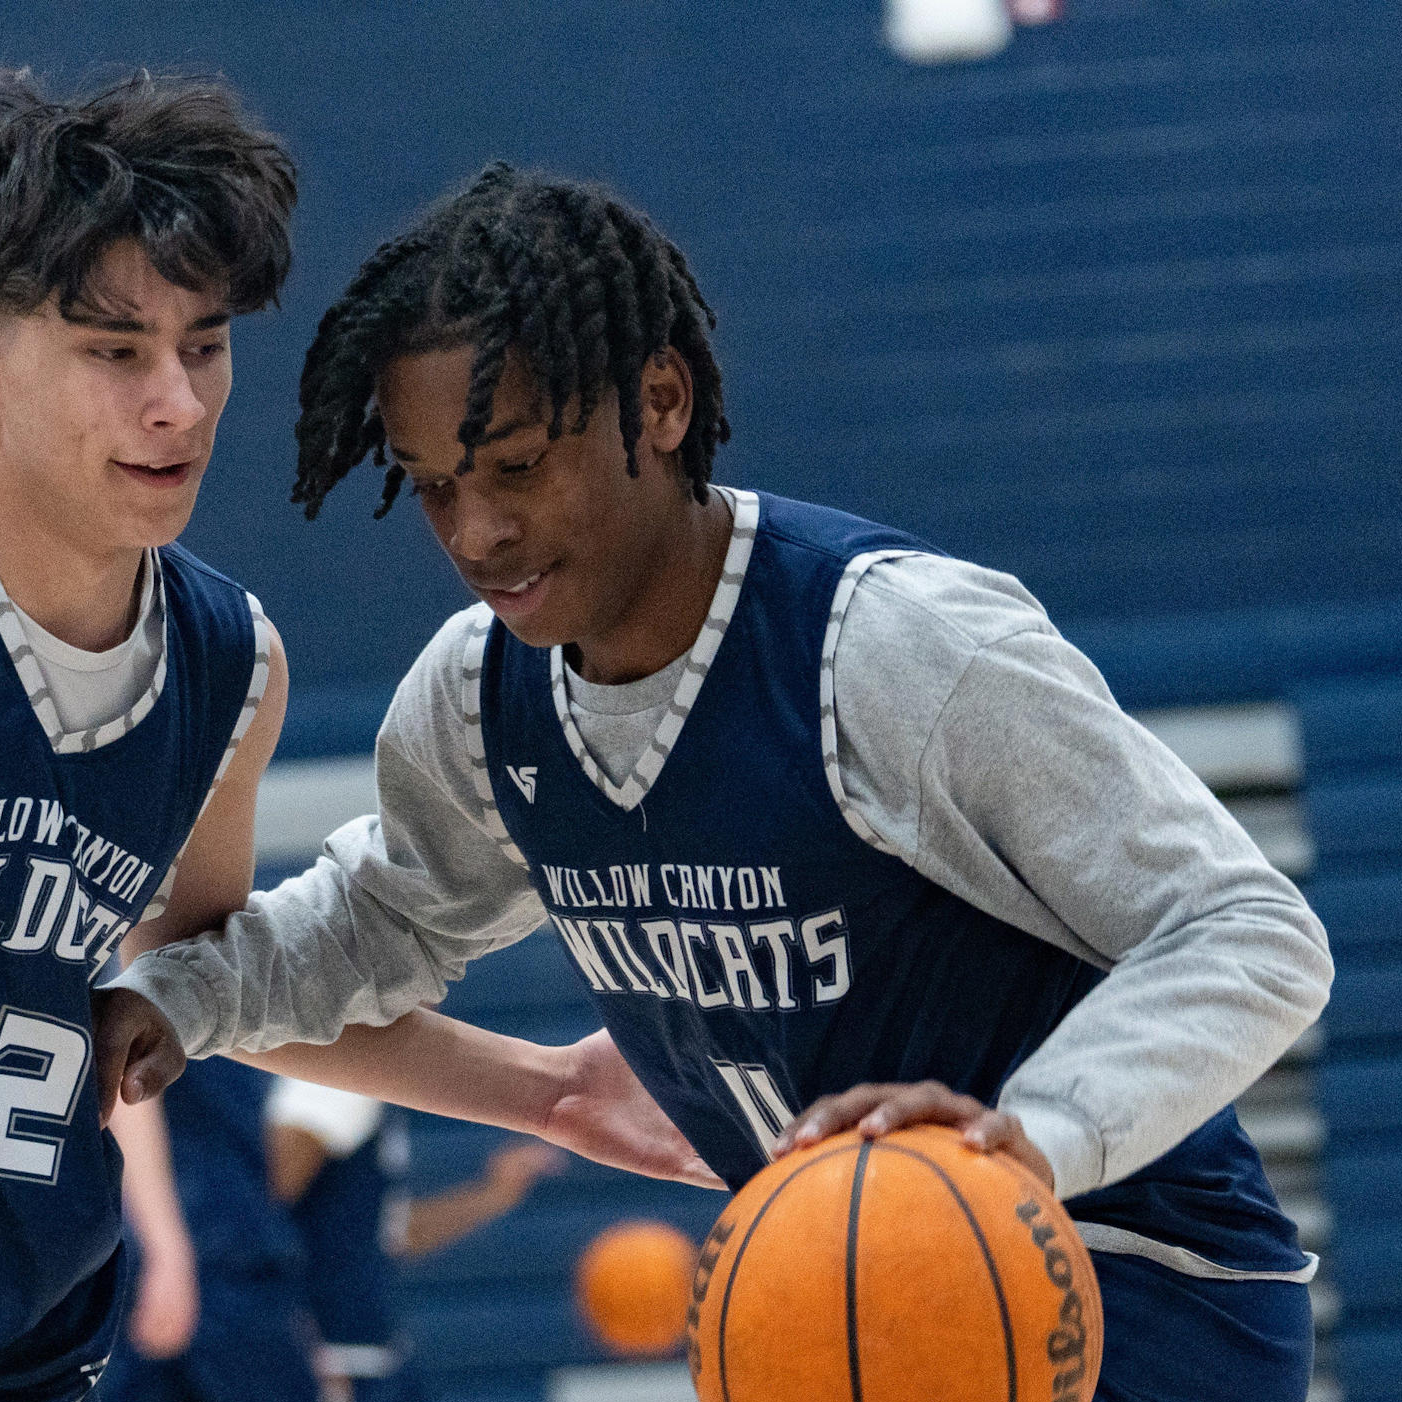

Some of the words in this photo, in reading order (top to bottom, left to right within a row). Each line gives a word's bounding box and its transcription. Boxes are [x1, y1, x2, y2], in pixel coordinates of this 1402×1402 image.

[541, 863, 653, 908] WILLOW
[660, 864, 787, 911] CANYON
[548, 905, 854, 1013] WILDCATS
